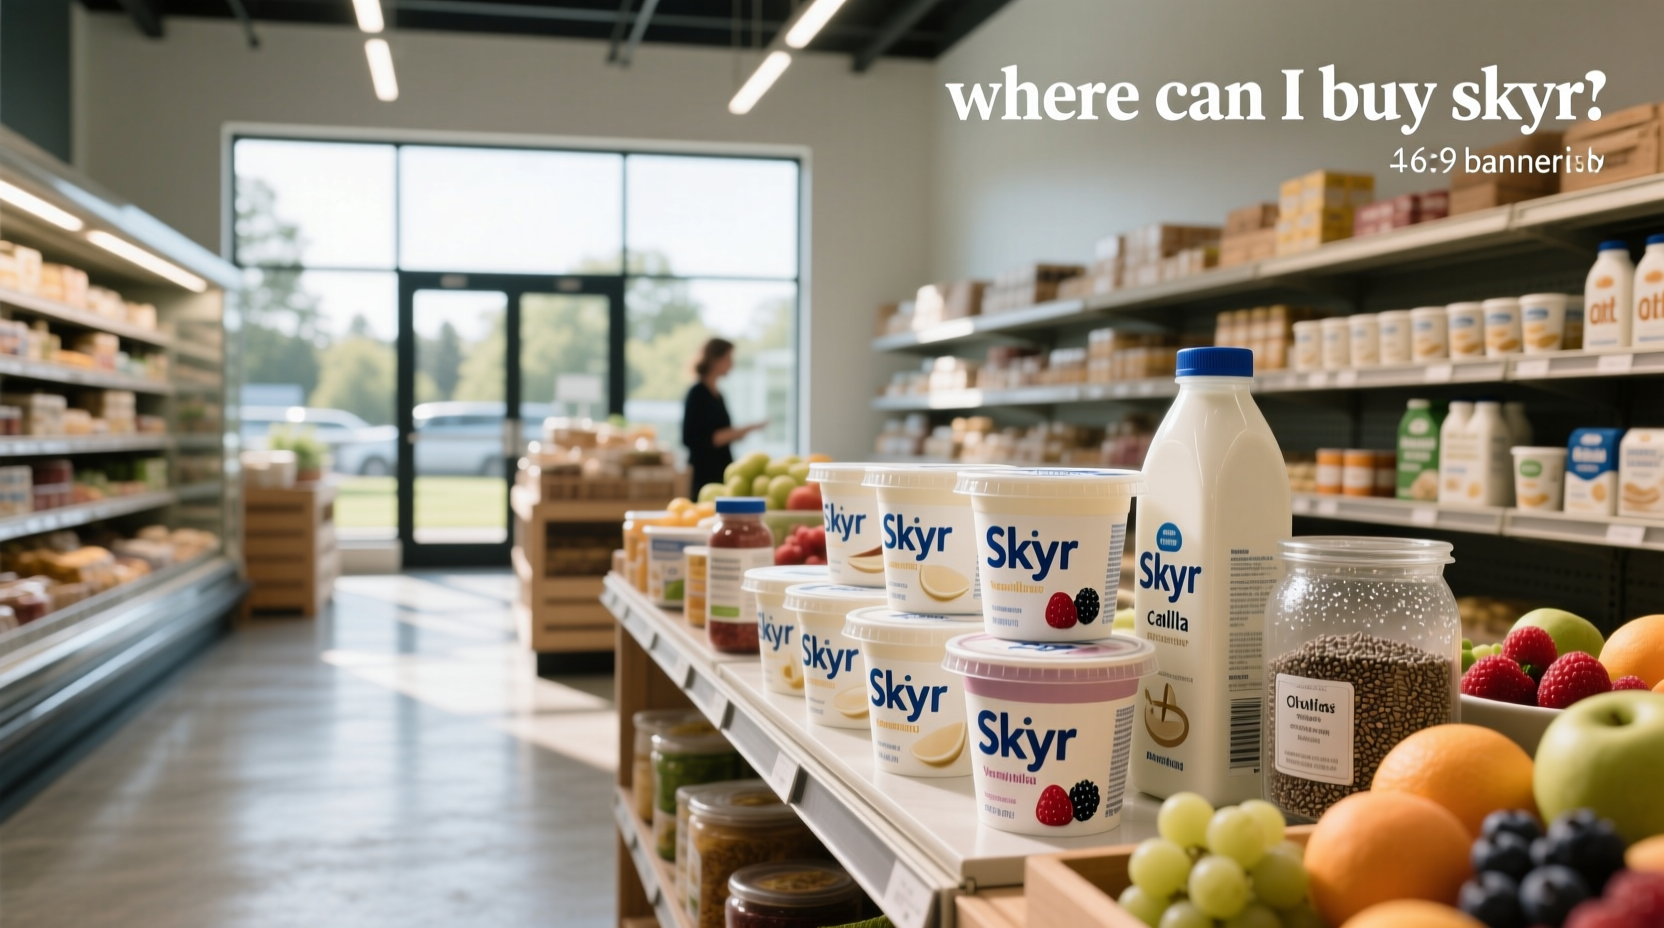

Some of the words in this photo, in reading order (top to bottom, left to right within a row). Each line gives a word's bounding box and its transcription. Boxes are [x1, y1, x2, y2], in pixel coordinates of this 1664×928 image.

[883, 513, 953, 561] Skyr
[986, 525, 1078, 582] Skyr
[1139, 551, 1202, 603] Skyr
[802, 633, 859, 680] Skyr
[869, 667, 948, 722] Skyr
[977, 710, 1077, 772] Skyr
